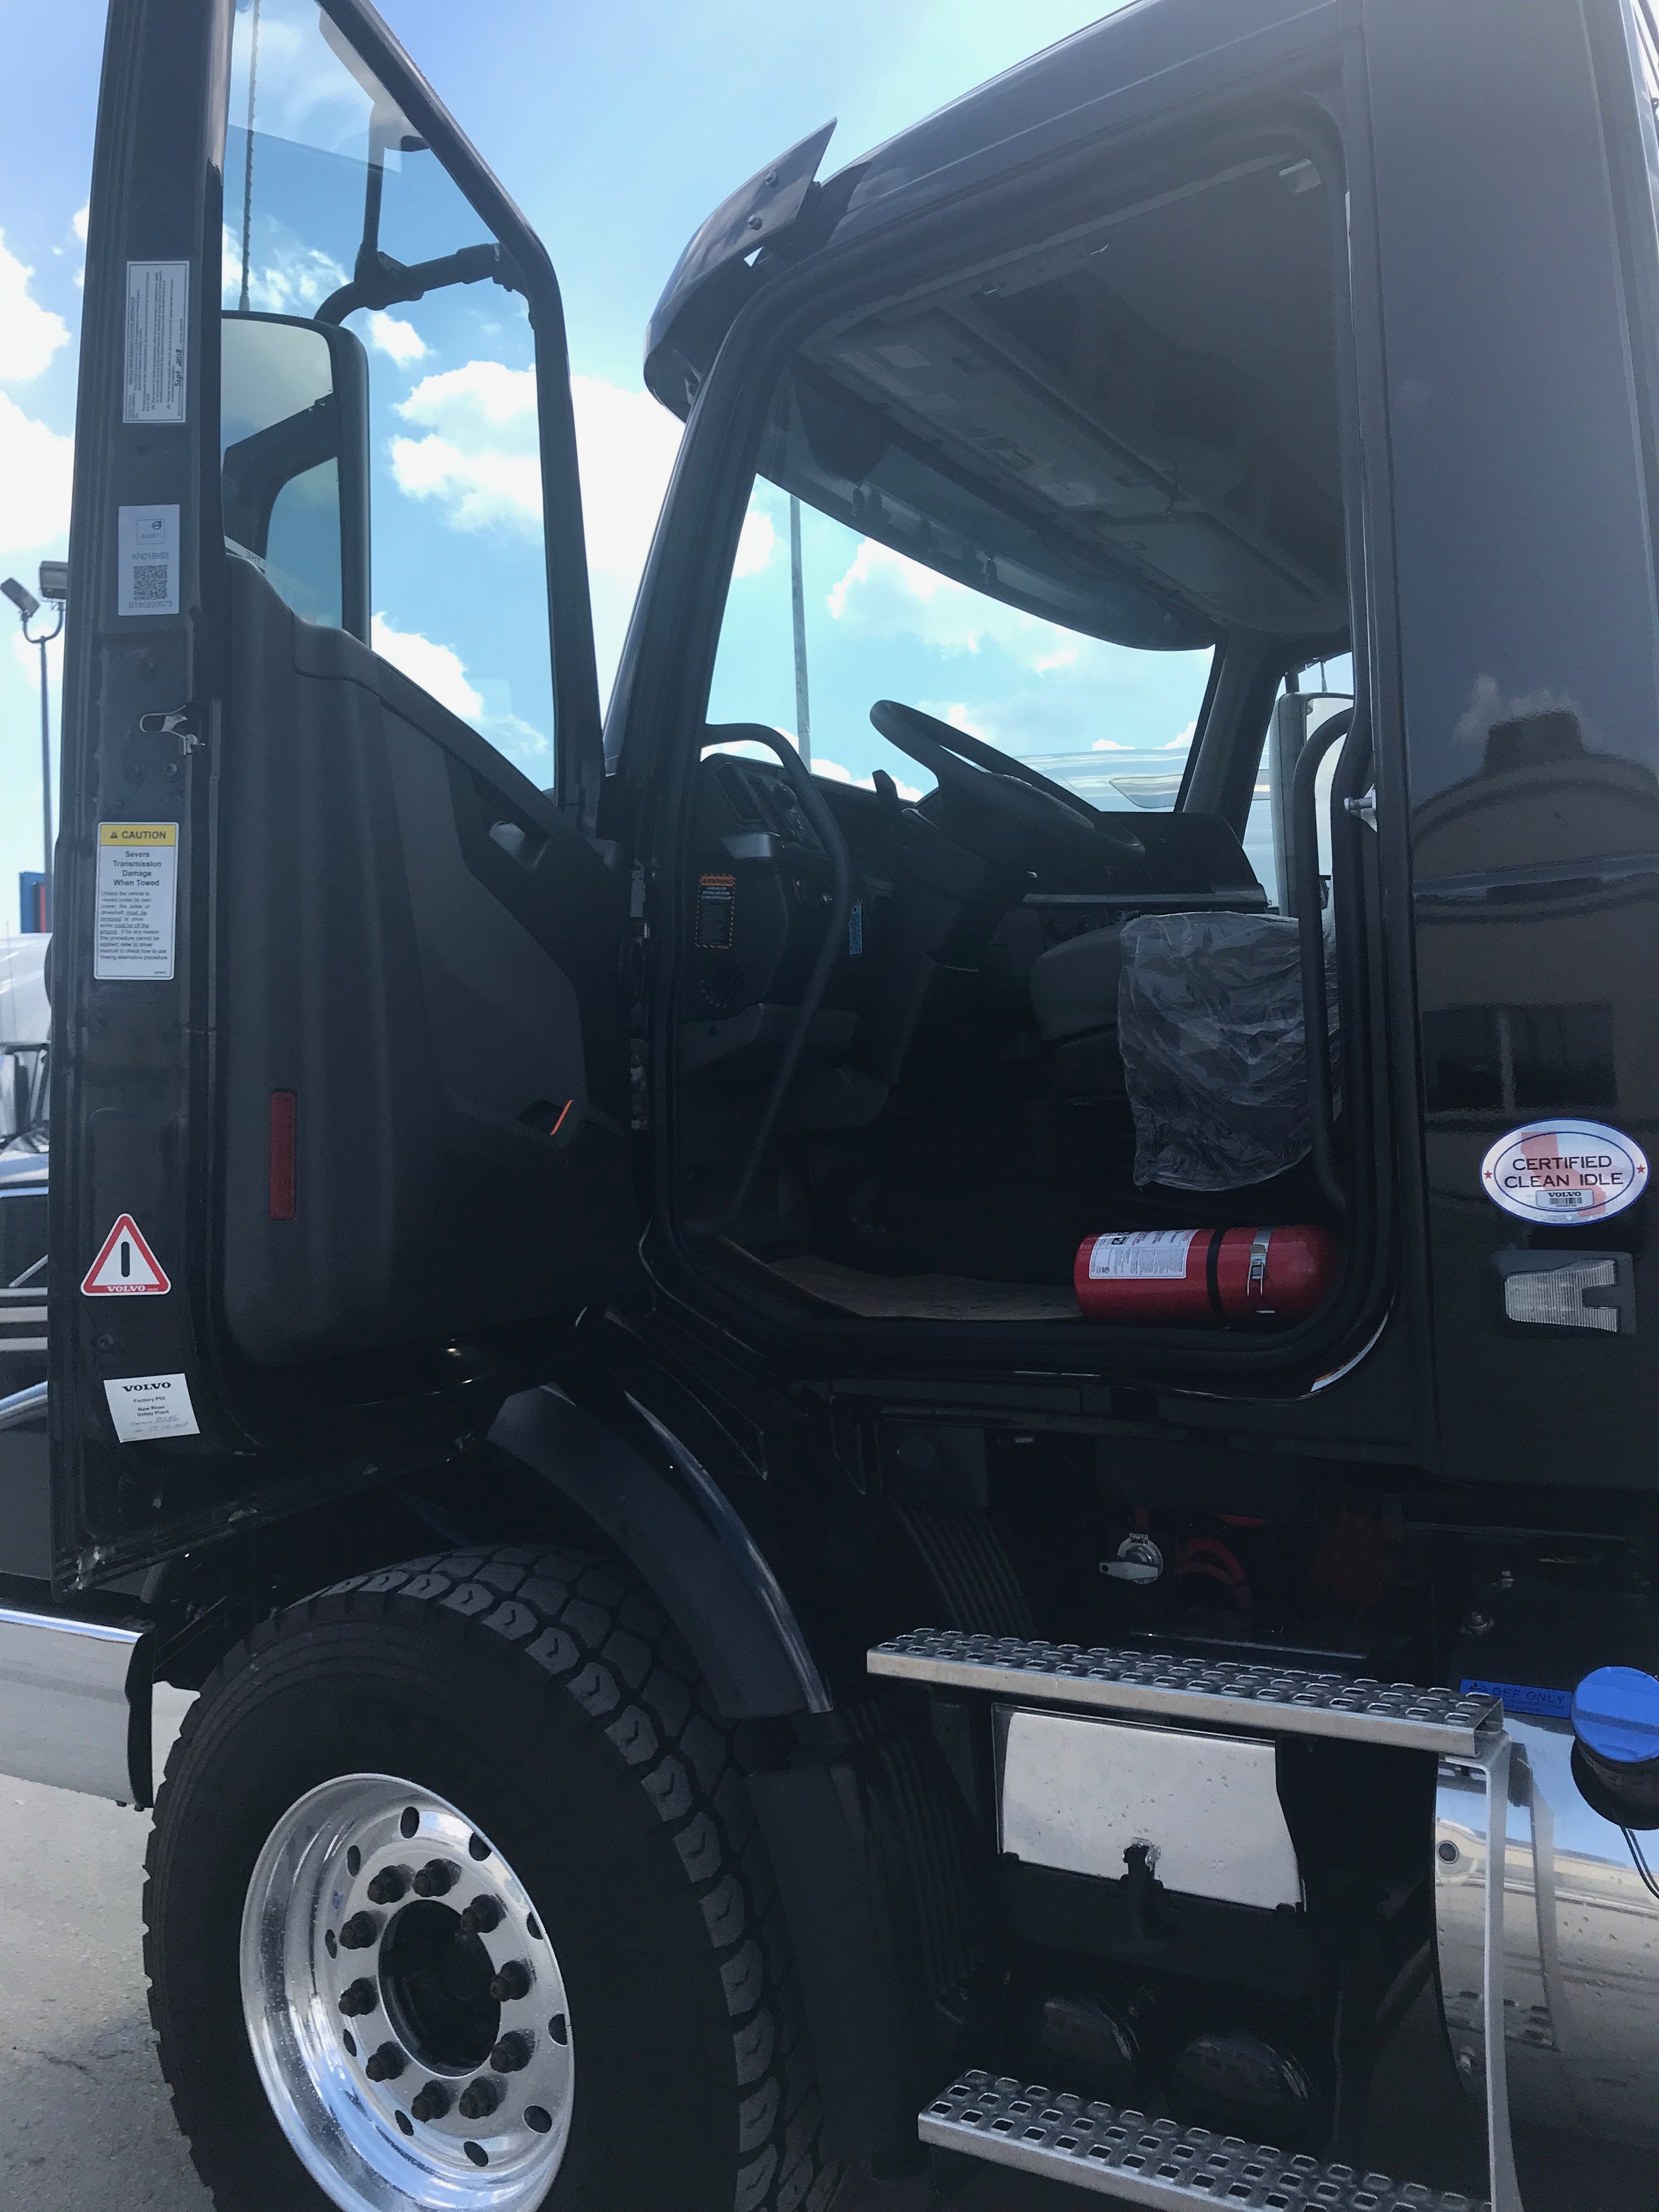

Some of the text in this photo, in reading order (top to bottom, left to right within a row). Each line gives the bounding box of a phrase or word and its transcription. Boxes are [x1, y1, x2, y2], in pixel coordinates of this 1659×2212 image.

[1512, 1155, 1612, 1171] CERTIFIED
[1504, 1172, 1624, 1189] CLEAN IDLE
[122, 1382, 171, 1392] VOLVO
[1493, 1688, 1565, 1704] DEF ONLY
